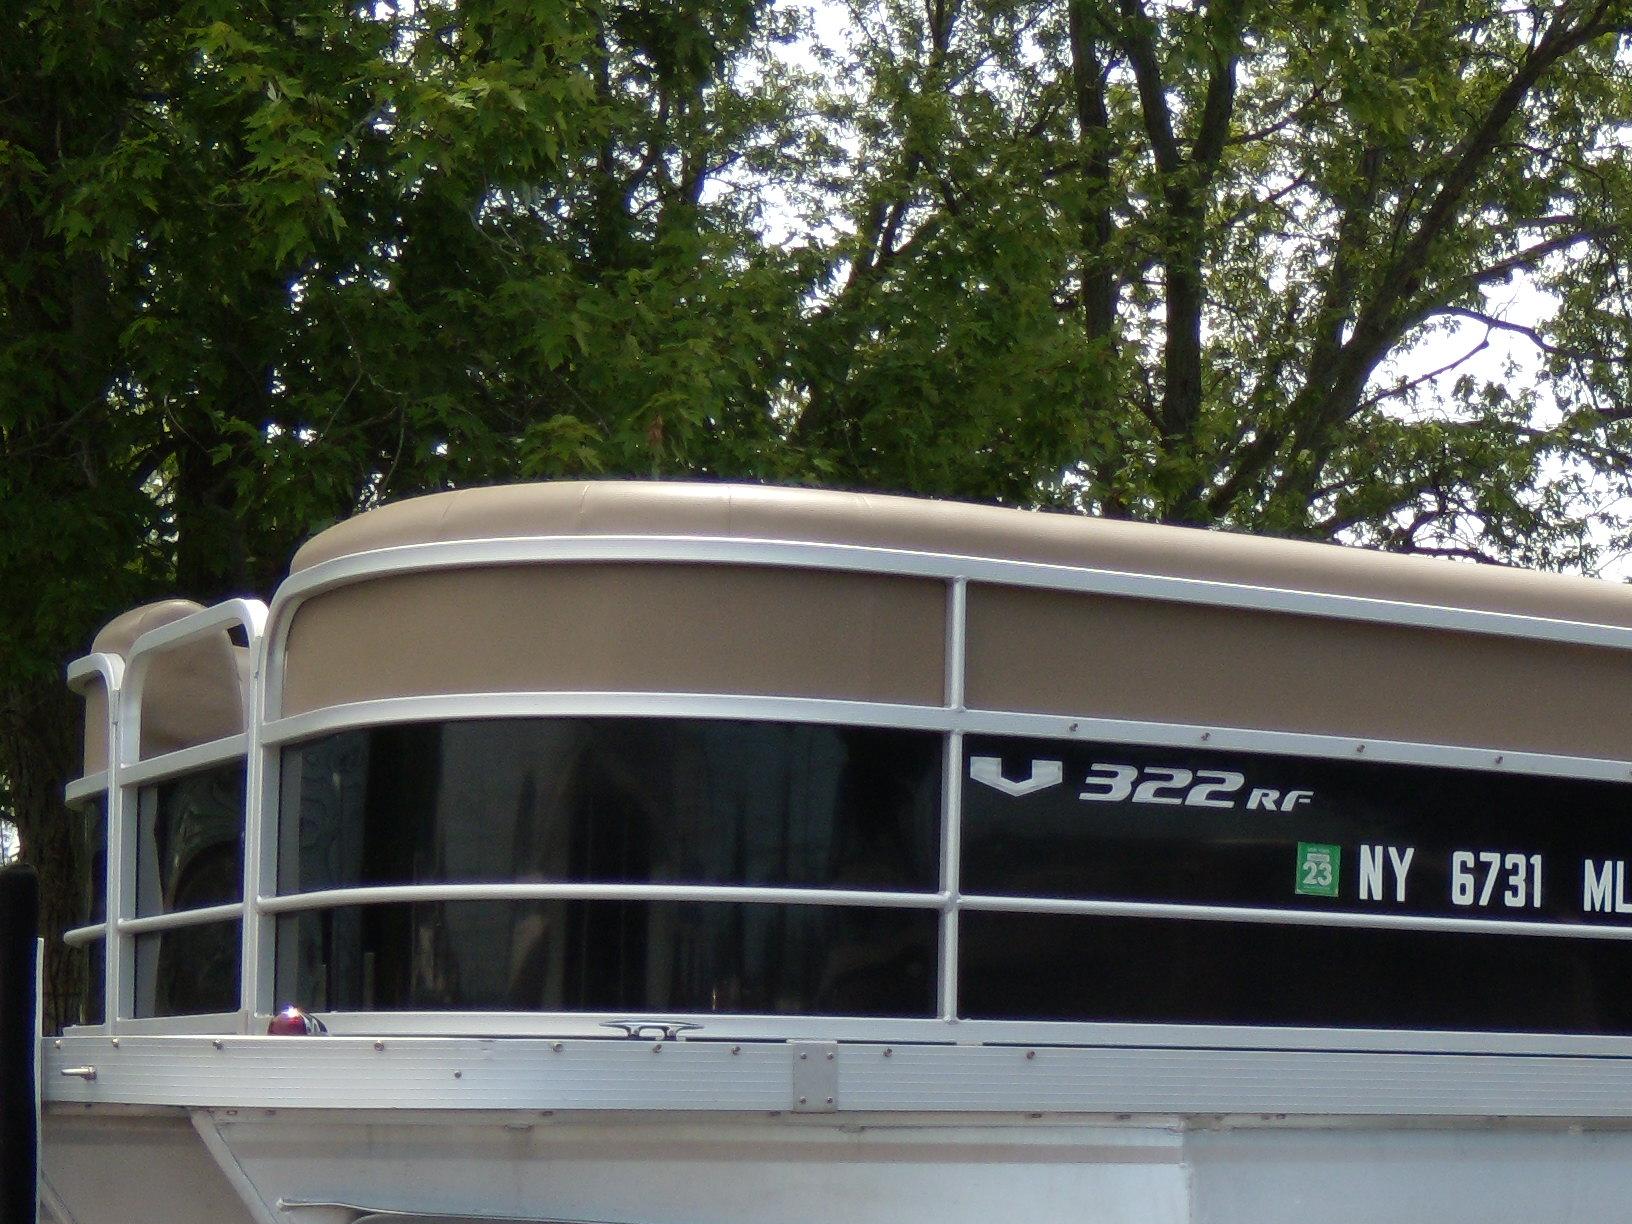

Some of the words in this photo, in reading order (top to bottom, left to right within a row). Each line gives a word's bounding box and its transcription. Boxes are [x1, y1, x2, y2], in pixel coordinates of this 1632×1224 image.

[1079, 763, 1245, 808] 322
[1246, 788, 1315, 812] RF
[1302, 861, 1333, 886] 23
[1359, 844, 1415, 902] NY
[1451, 850, 1542, 908] 6731
